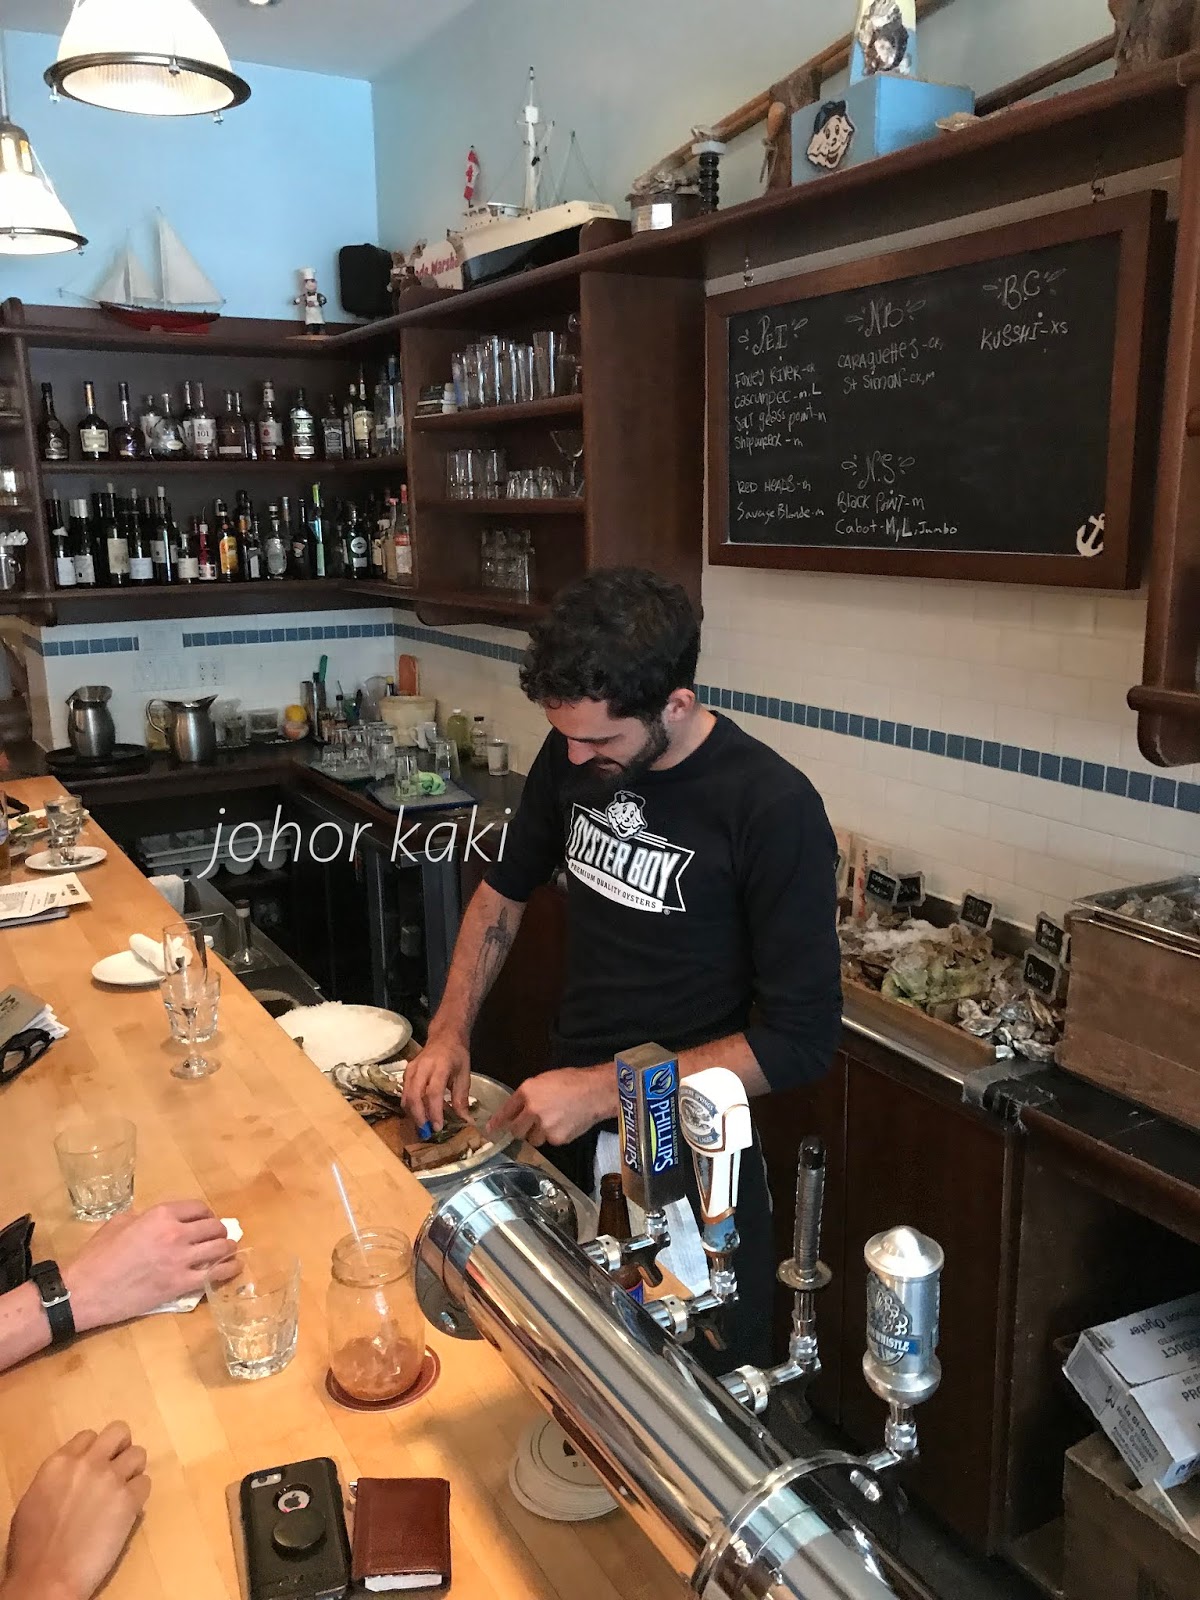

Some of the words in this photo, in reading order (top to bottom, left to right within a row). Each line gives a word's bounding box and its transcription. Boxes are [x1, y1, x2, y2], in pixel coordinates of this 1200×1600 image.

[568, 813, 632, 881] OYSTER
[626, 846, 682, 901] BOY
[570, 862, 596, 883] PREMIUM
[596, 877, 622, 897] QUALITY
[622, 891, 657, 910] OYSTERS
[620, 1095, 638, 1170] PHILLIPS
[650, 1099, 674, 1173] PHILLIPS
